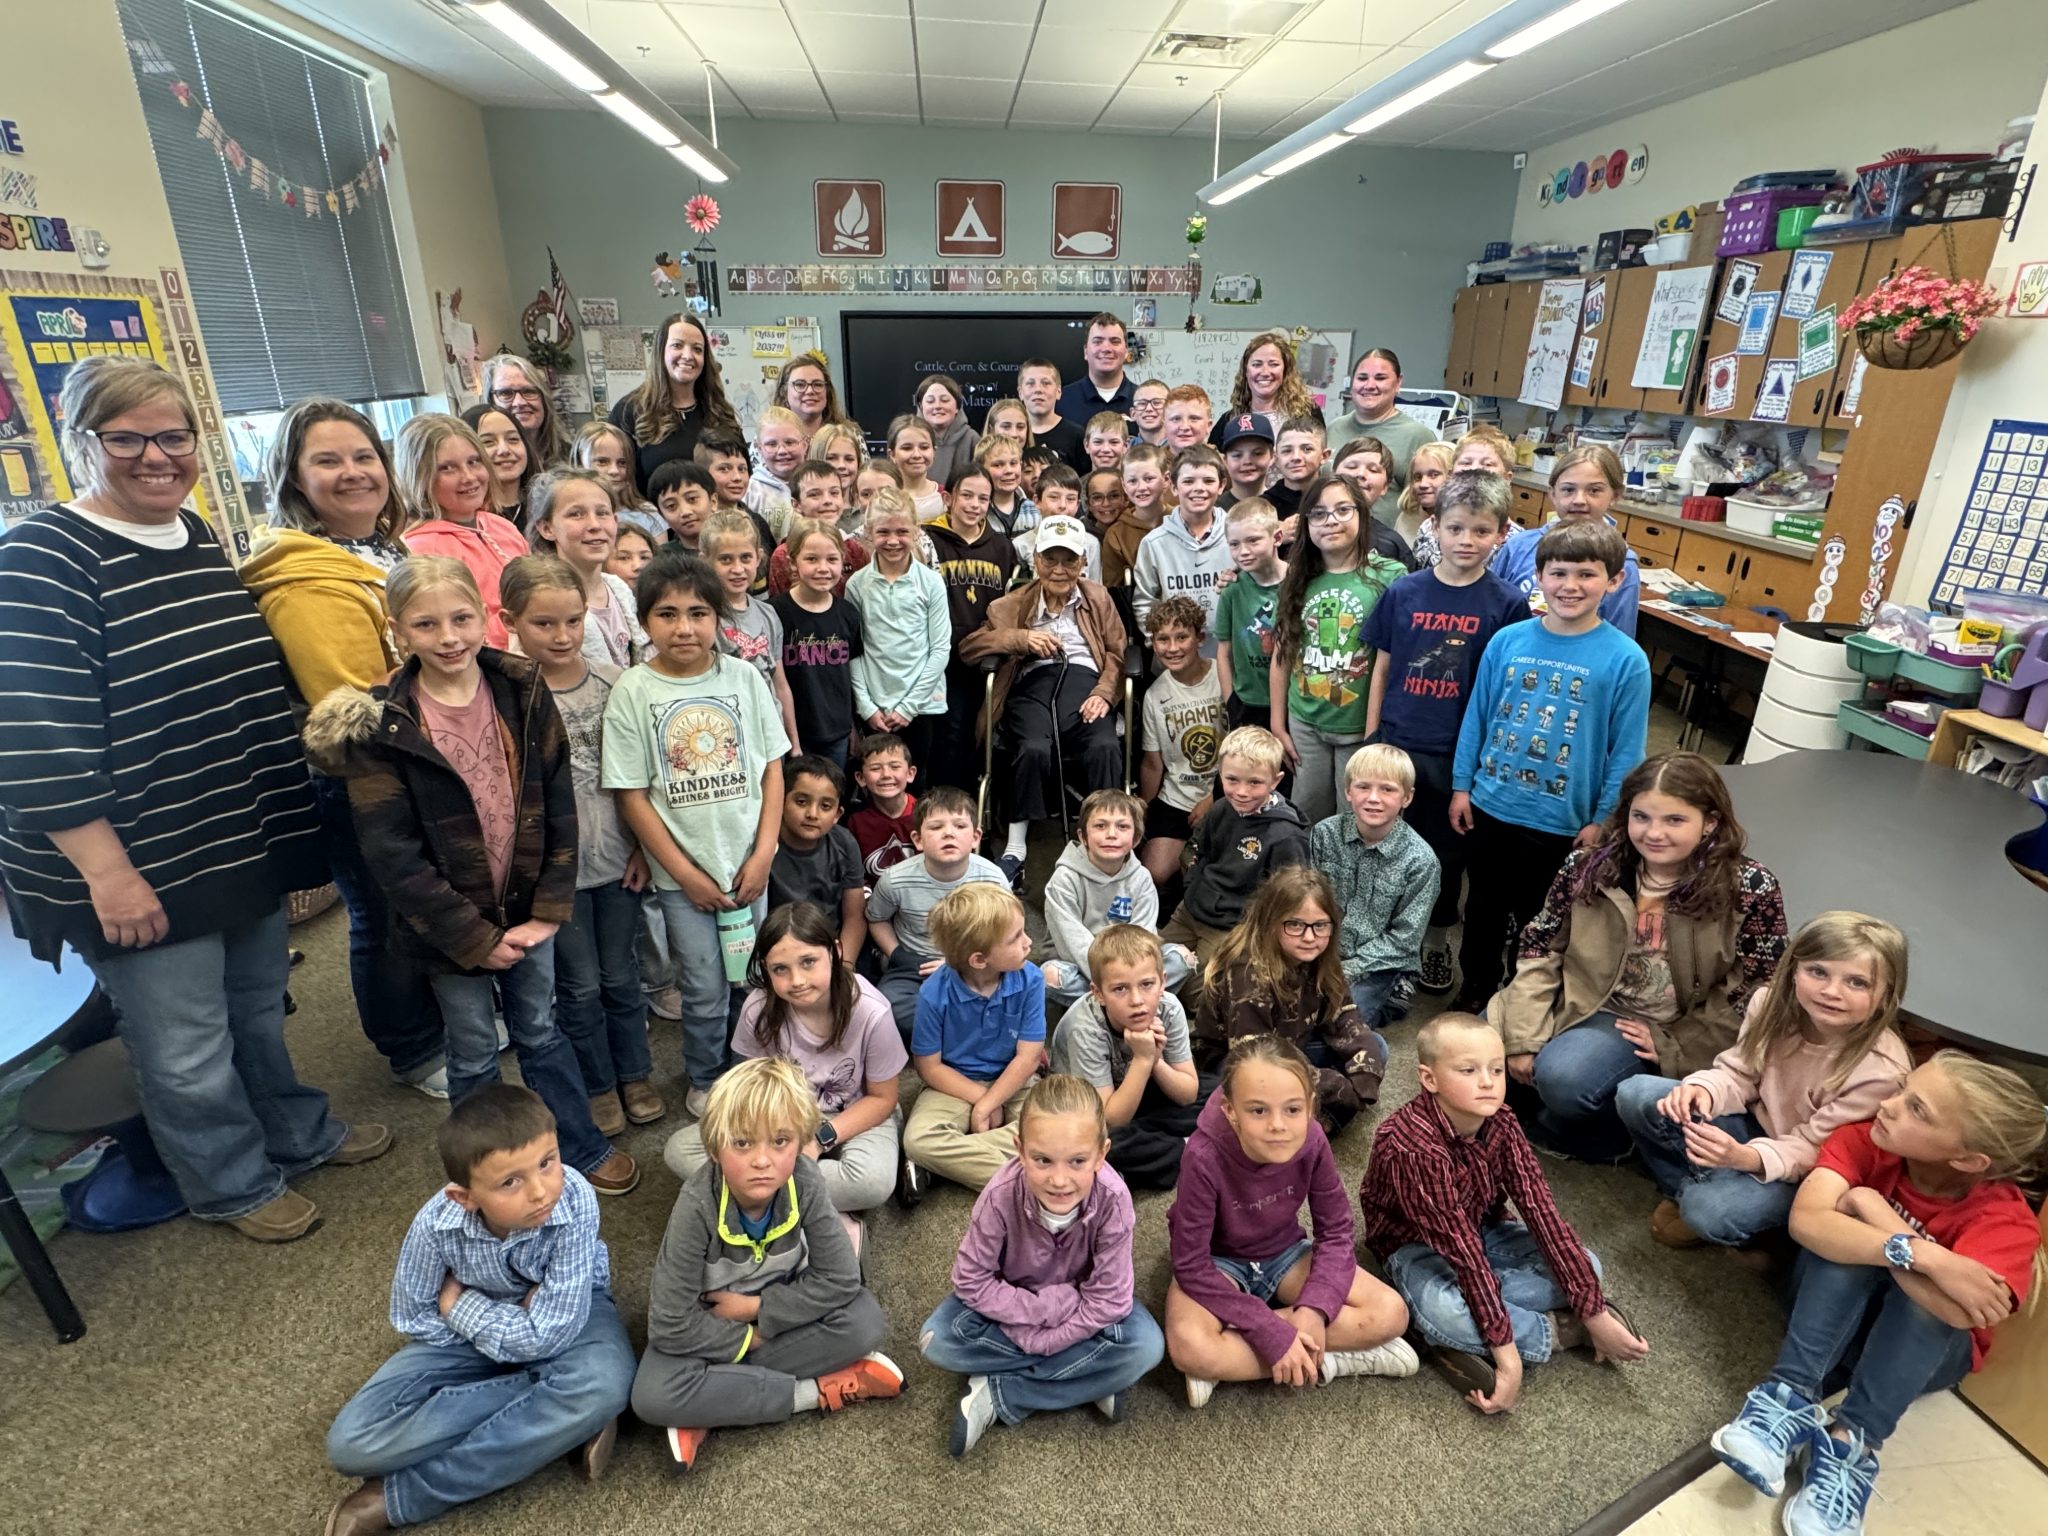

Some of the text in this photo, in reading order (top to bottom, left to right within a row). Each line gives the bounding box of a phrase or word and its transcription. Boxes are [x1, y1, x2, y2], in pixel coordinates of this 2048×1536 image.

[166, 272, 179, 295] 0
[730, 271, 745, 284] Aa
[749, 271, 764, 284] Bb
[767, 271, 782, 284] Cc
[784, 271, 800, 284] Dd
[804, 271, 818, 284] Ee
[822, 271, 839, 284] Ff
[839, 270, 855, 291] Gg
[858, 271, 874, 284] Hh
[878, 271, 890, 284] Ii
[895, 270, 909, 291] Jj
[914, 271, 928, 284] Kk
[933, 271, 945, 285] Ll
[950, 271, 965, 285] Mm
[968, 271, 983, 285] Nn
[986, 271, 1001, 285] Oo
[1005, 271, 1019, 290] Pp
[1022, 271, 1038, 291] Qq
[1042, 271, 1057, 284] Rr
[1059, 271, 1073, 285] Ss
[1077, 271, 1091, 285] Tt
[1095, 270, 1110, 285] Uu
[1113, 271, 1127, 285] Vv
[1131, 271, 1147, 285] Ww
[1150, 271, 1164, 285] Xx
[1167, 271, 1182, 290] Yy
[2022, 293, 2036, 304] 50
[179, 308, 187, 329] 1
[185, 341, 198, 363] 2
[914, 360, 947, 373] Cattle,
[948, 361, 976, 373] Corn,
[977, 361, 989, 372] &
[195, 375, 206, 397] 3
[205, 412, 215, 429] 4
[213, 440, 224, 461] 5
[1997, 435, 2044, 451] 1 2 3
[1988, 456, 2000, 467] 11
[2026, 459, 2038, 472] 13
[222, 473, 232, 493] 6
[1980, 476, 1992, 488] 21
[1999, 477, 2014, 489] 22
[2018, 480, 2033, 492] 23
[228, 503, 239, 523] 7
[1973, 494, 1986, 505] 31
[2009, 500, 2024, 512] 33
[2028, 502, 2043, 516] 34
[1967, 513, 1980, 525] 41
[1985, 516, 1999, 529] 42
[2004, 518, 2019, 530] 43
[238, 532, 248, 552] 8
[1874, 525, 1889, 540] 10
[1960, 532, 1973, 544] 51
[1995, 536, 2010, 549] 53
[1872, 541, 1891, 560] 20
[1952, 549, 2043, 578] 61 62 63 64 65
[940, 558, 1003, 591] WYOMING
[1167, 571, 1219, 590] COLORA
[1949, 569, 1960, 581] 71
[1963, 571, 1977, 585] 72
[1981, 575, 1996, 588] 73
[1939, 586, 1952, 599] 81
[1411, 612, 1480, 635] PIANO
[784, 641, 850, 666] DANCE
[1511, 656, 1590, 676] CAREER OPPORTUNITIES
[1404, 675, 1460, 698] NINJA
[668, 771, 747, 795] KINDNESS
[671, 785, 747, 804] SHINES BRIGHT
